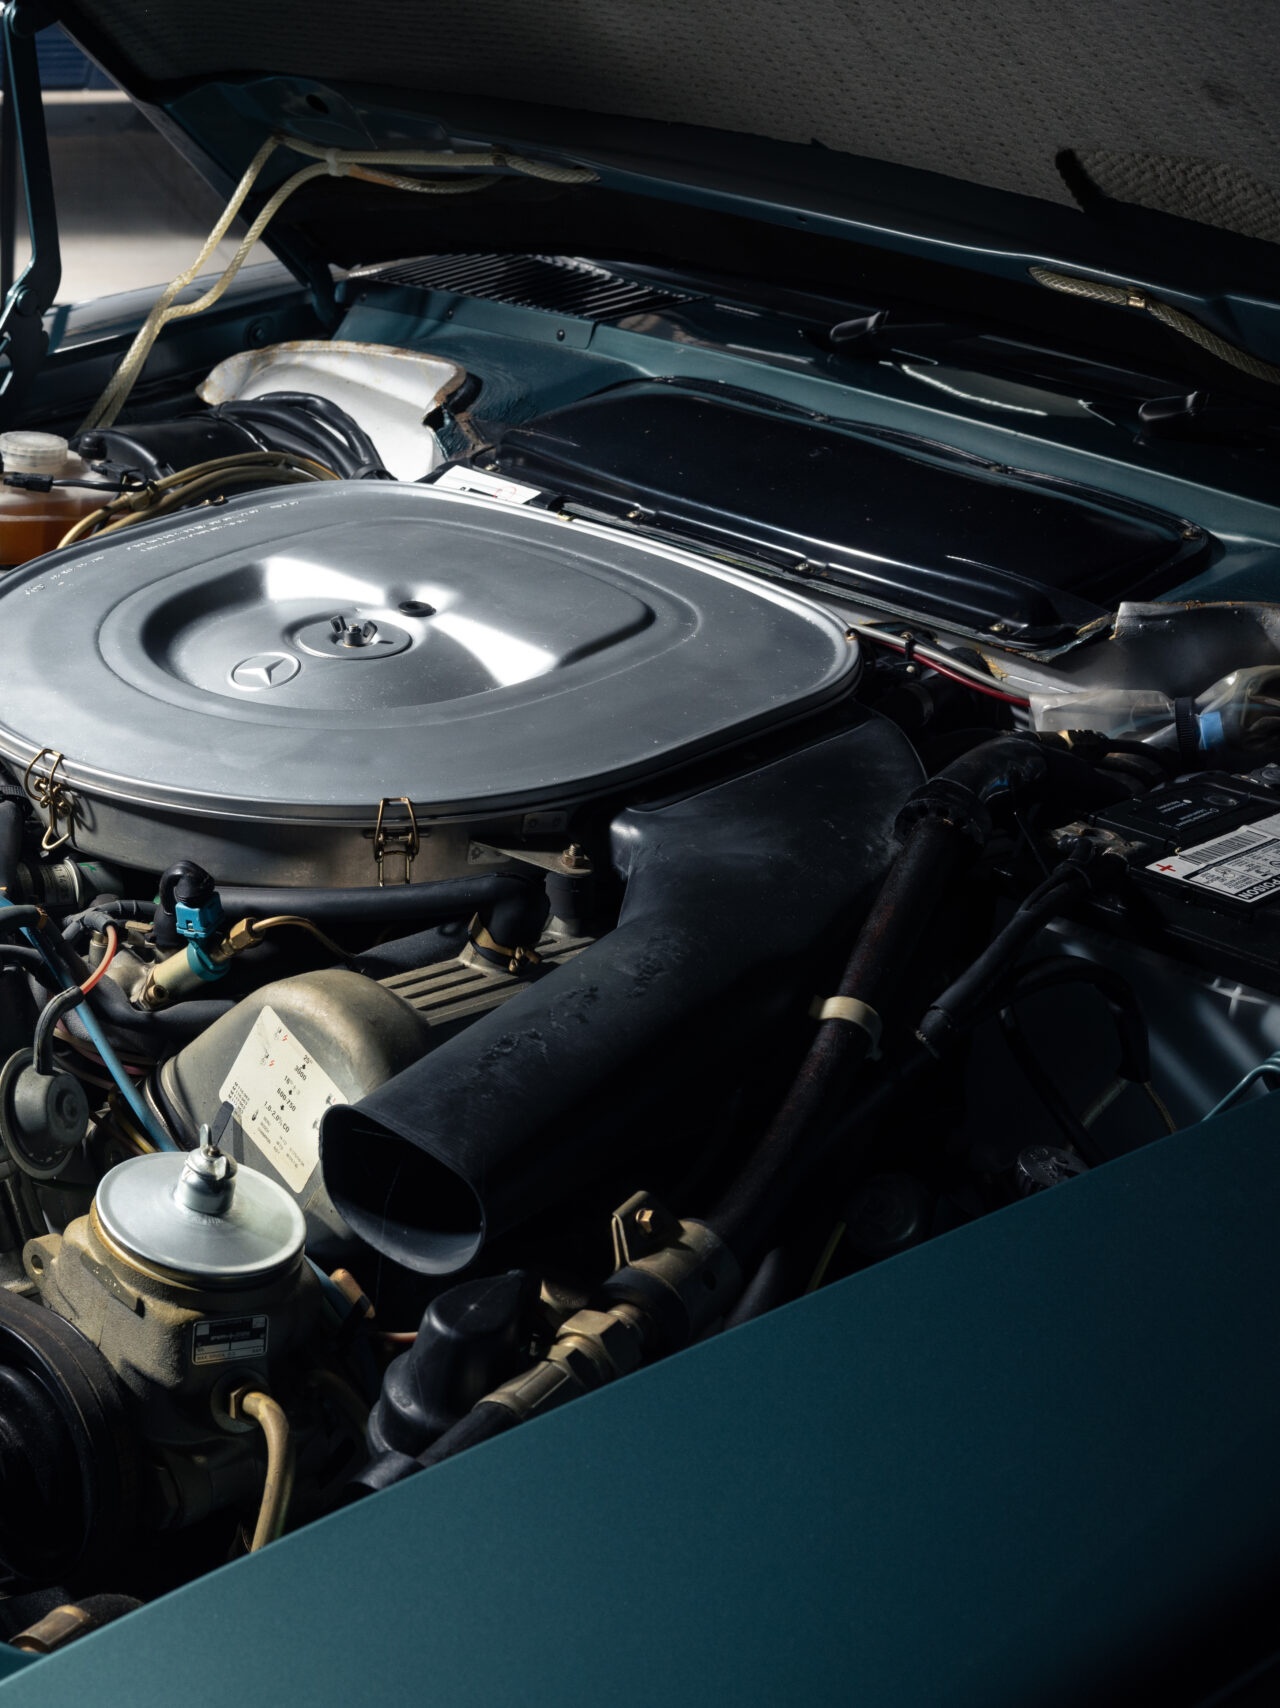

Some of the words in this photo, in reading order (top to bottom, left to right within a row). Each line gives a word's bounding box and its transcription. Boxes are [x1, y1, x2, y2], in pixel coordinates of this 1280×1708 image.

[1238, 877, 1279, 899] POISON
[294, 1065, 306, 1081] 3000
[282, 1122, 289, 1133] CO
